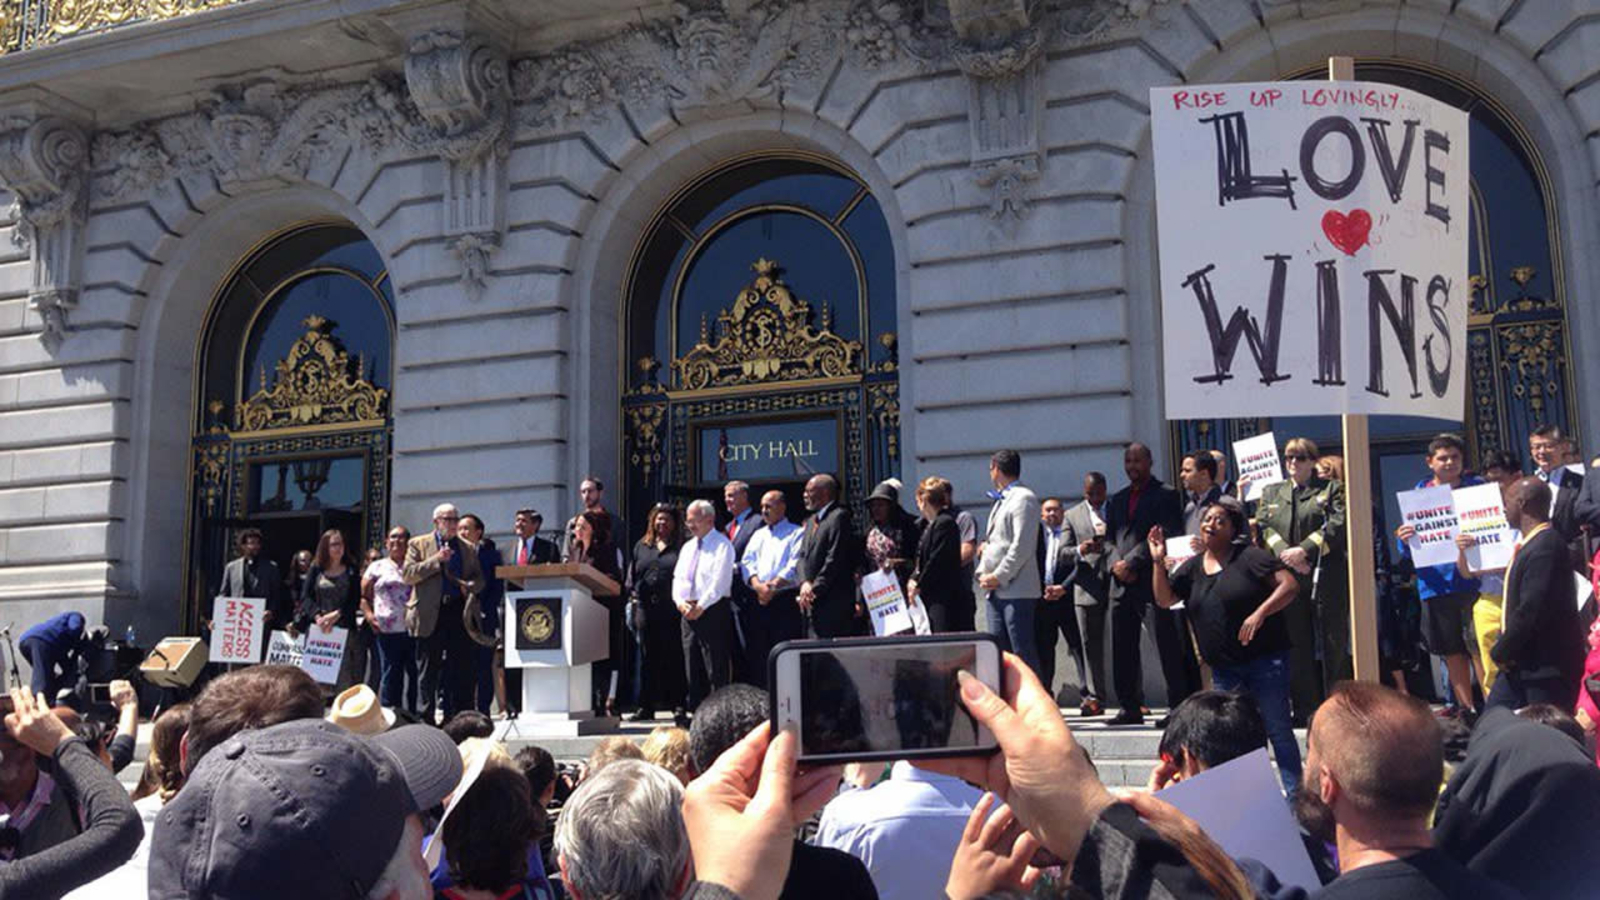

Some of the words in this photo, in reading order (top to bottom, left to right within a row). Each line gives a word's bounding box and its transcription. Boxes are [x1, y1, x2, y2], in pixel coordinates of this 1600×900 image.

[1173, 91, 1227, 110] RISE
[1250, 90, 1282, 107] UP
[1198, 111, 1451, 233] LOVE
[1181, 253, 1453, 398] WINS
[720, 444, 763, 462] CITY
[769, 440, 818, 459] HALL
[1241, 450, 1274, 464] #UNITE
[1241, 459, 1278, 475] AGAINST
[1406, 506, 1452, 521] #UNITE
[1460, 506, 1500, 521] #UNITE
[1415, 518, 1459, 533] GAINST
[1419, 530, 1452, 544] HATE
[221, 601, 236, 658] MATTERS
[235, 601, 254, 659] ACCESS
[309, 640, 341, 650] #UNITE
[305, 648, 342, 659] AGAINST
[310, 657, 332, 667] HATE
